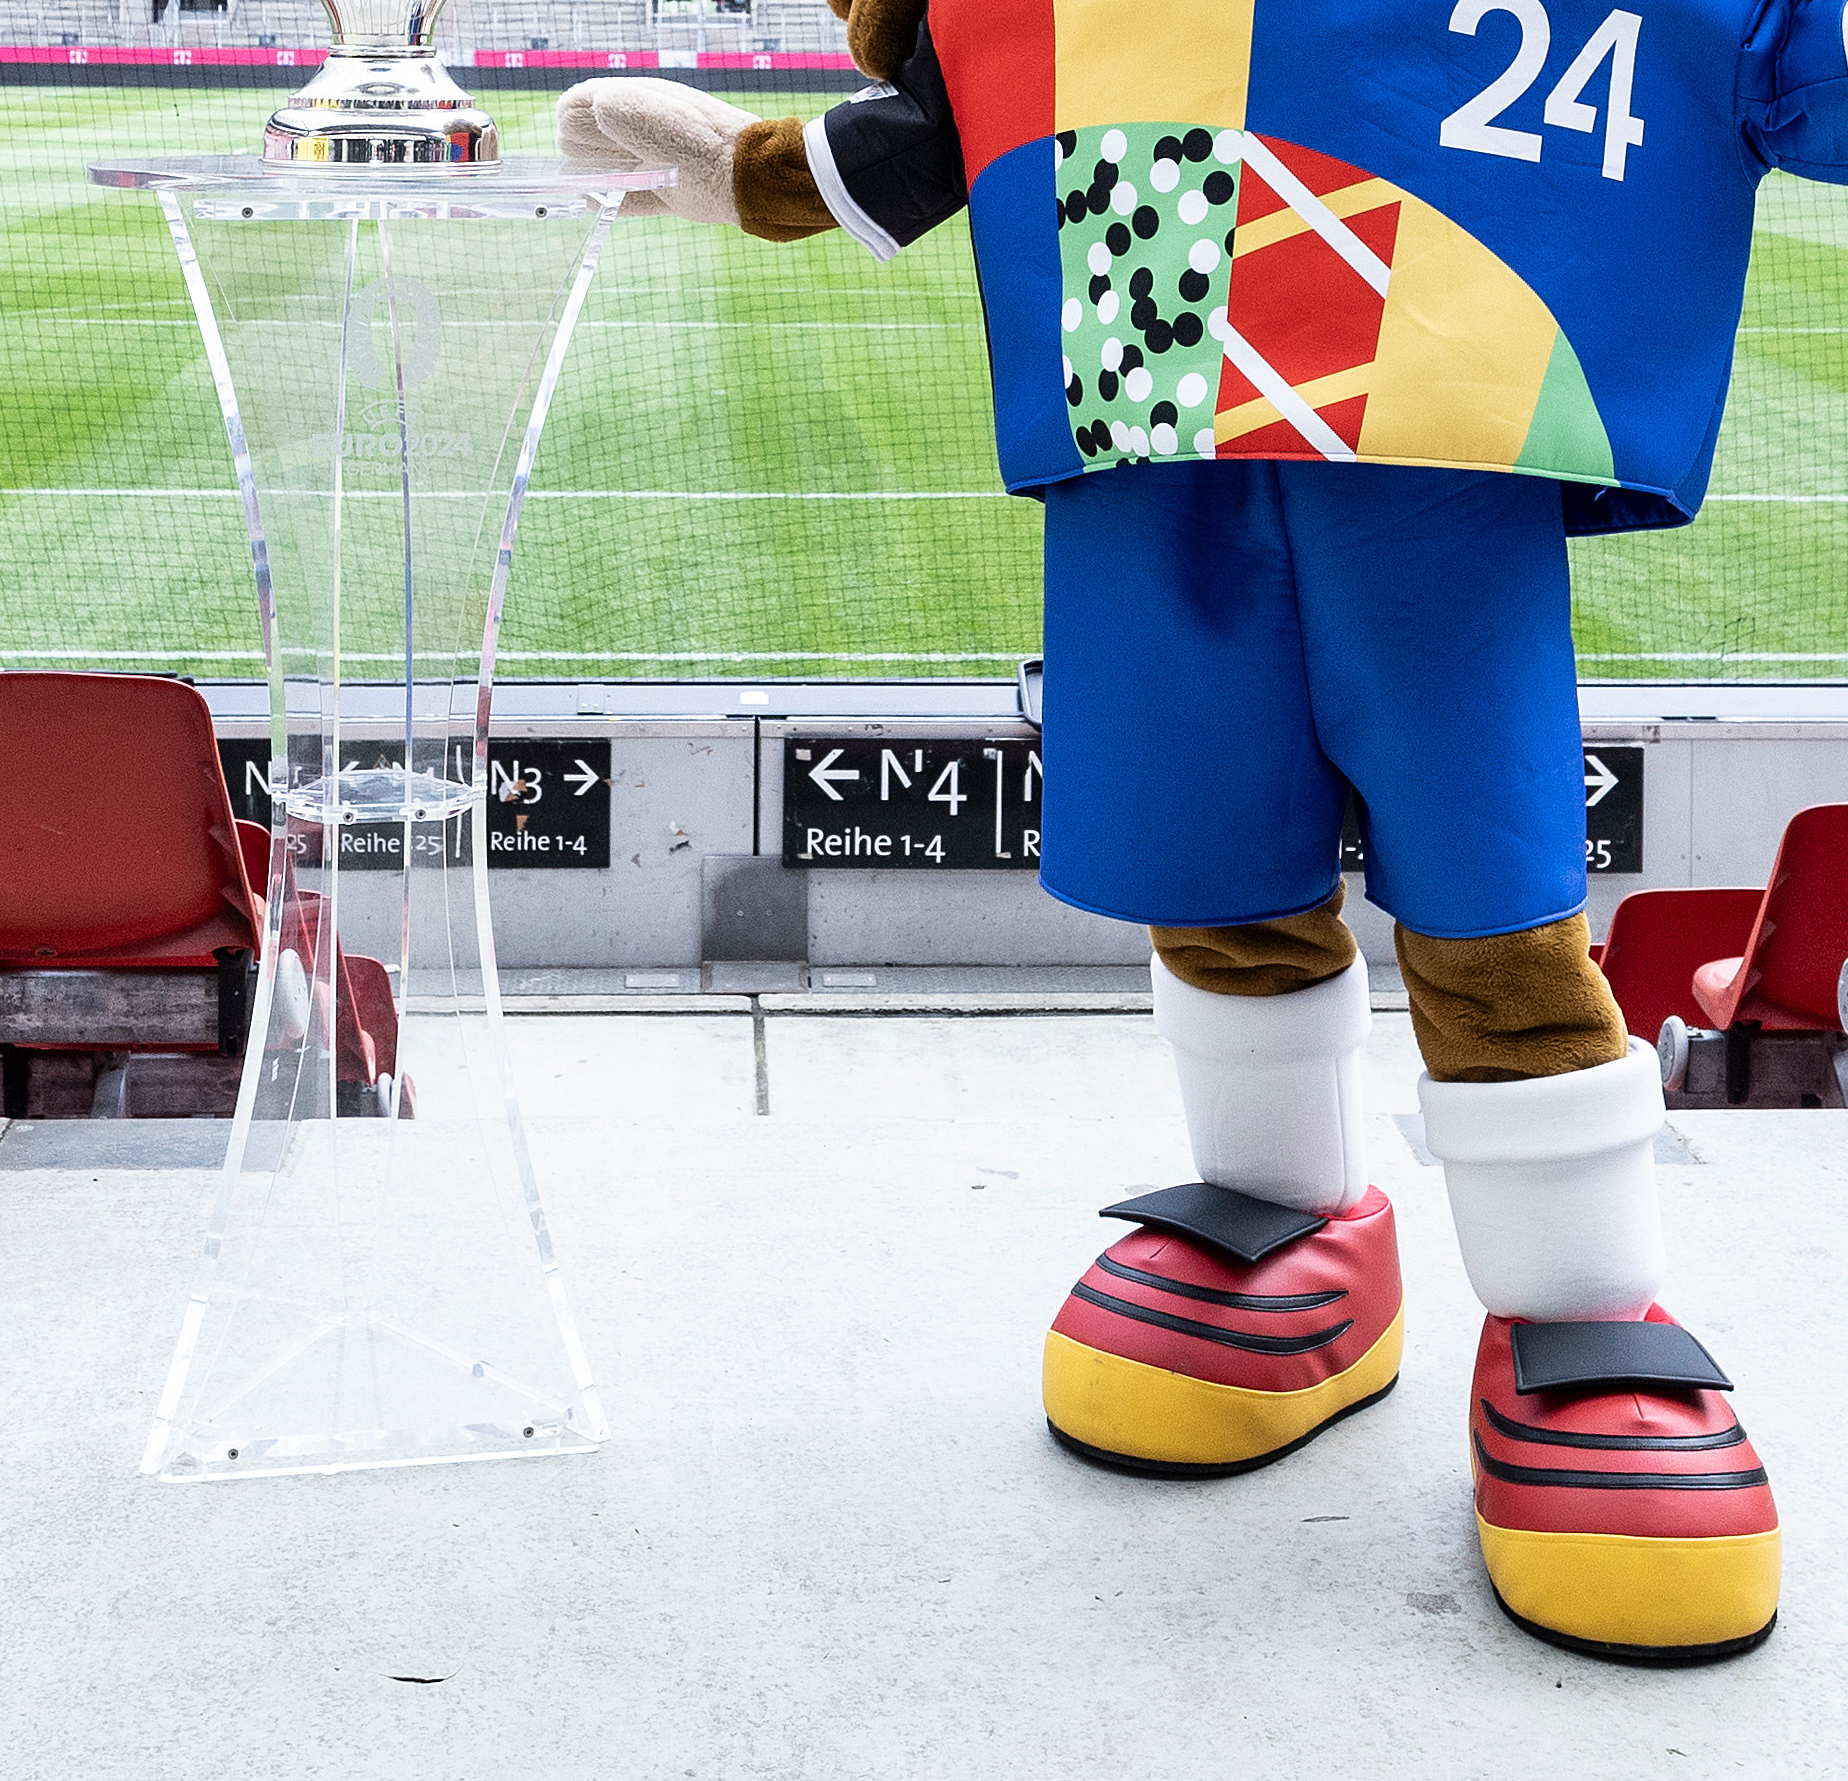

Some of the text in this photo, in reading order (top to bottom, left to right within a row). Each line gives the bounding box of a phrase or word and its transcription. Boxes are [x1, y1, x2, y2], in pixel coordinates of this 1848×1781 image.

[491, 760, 543, 804] N3
[341, 833, 400, 853] Reihe
[491, 831, 588, 856] Reihe 1-4
[807, 826, 946, 863] Reihe 1-4
[1584, 839, 1612, 869] 25
